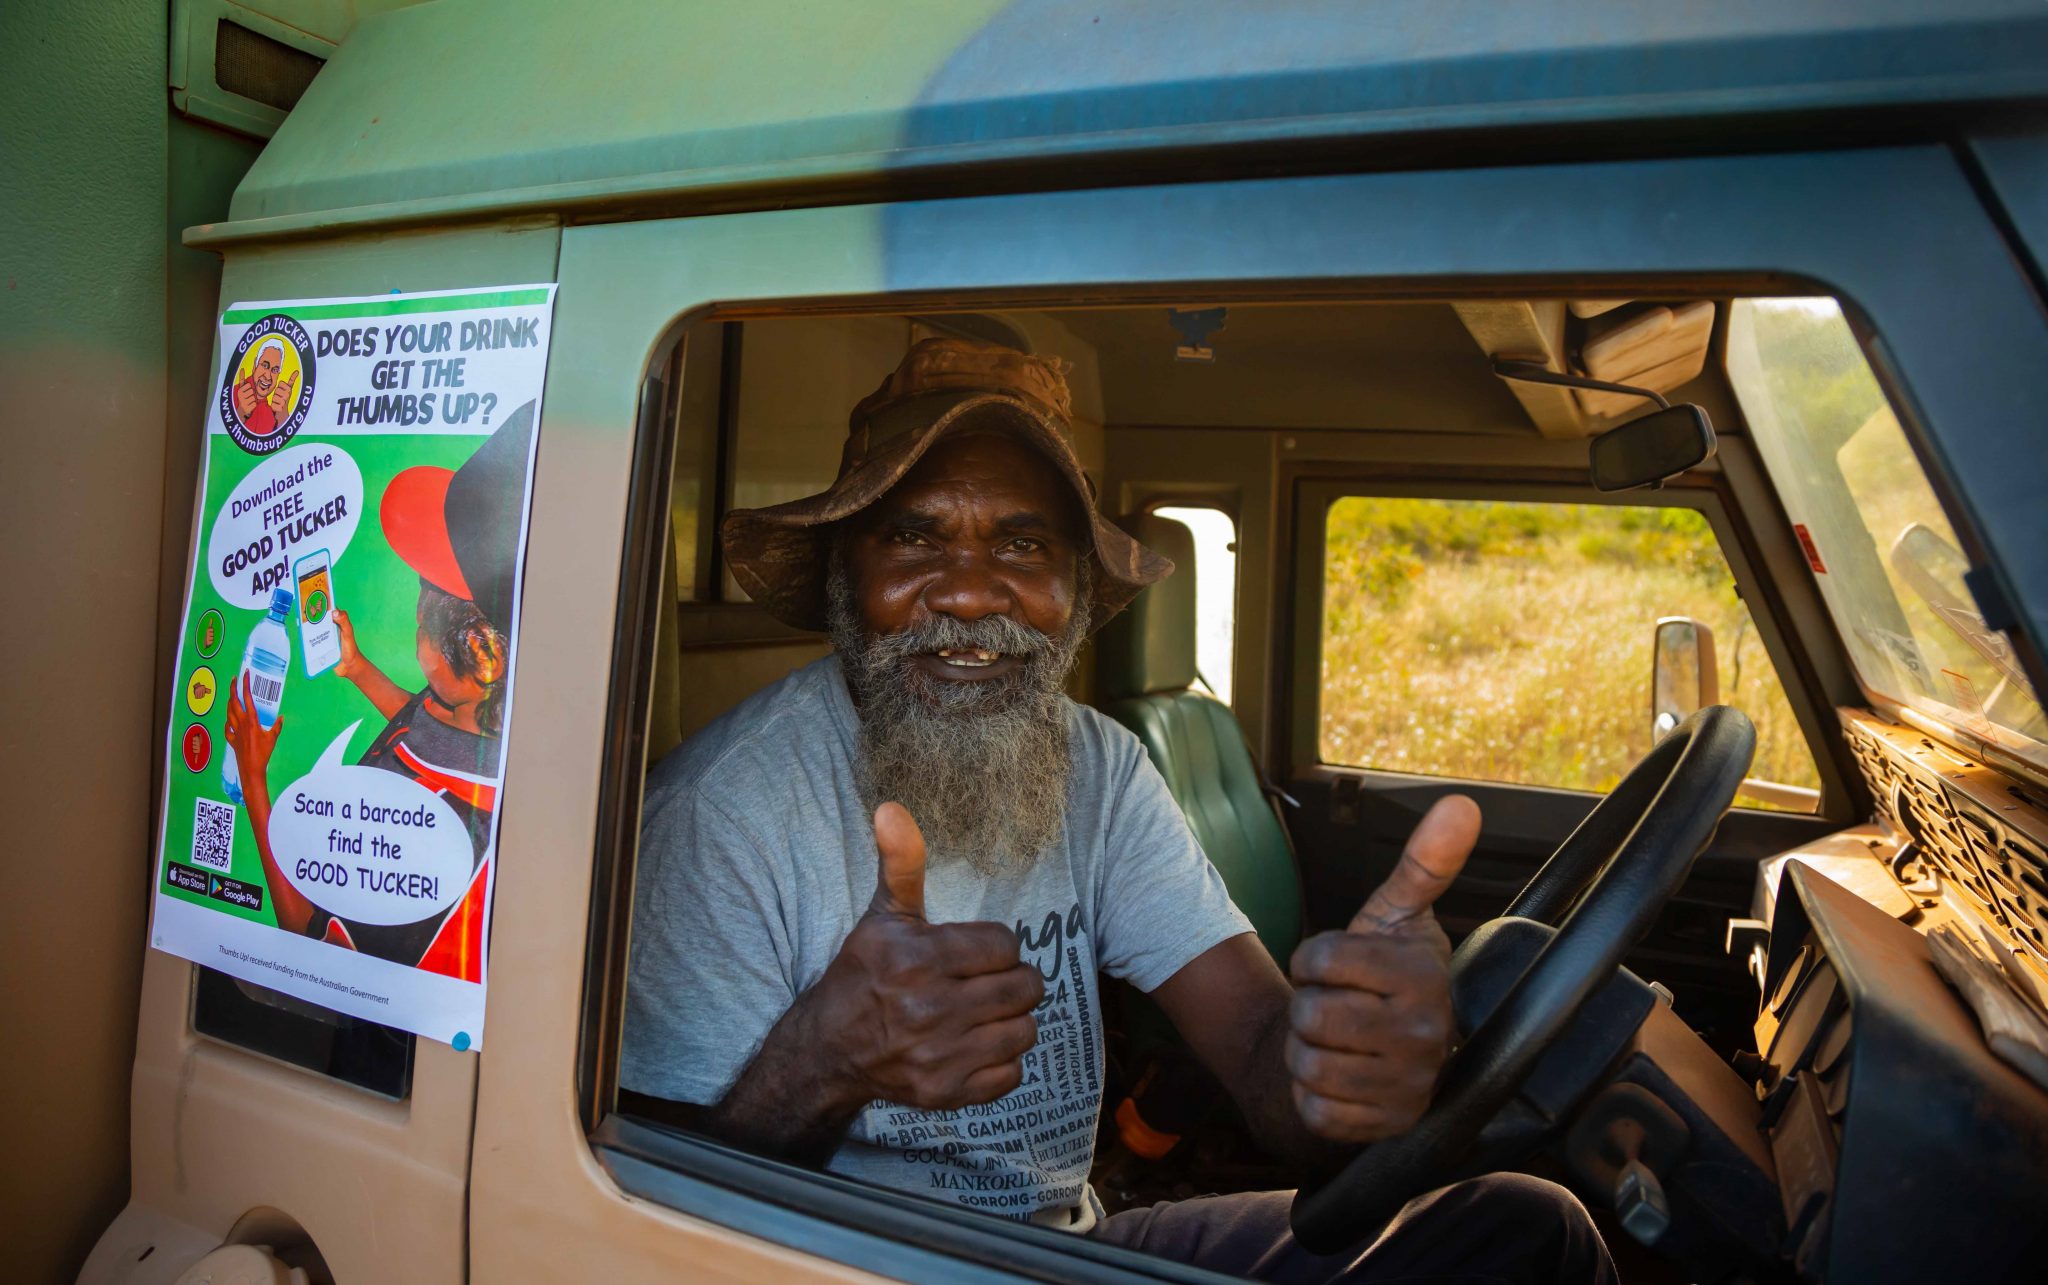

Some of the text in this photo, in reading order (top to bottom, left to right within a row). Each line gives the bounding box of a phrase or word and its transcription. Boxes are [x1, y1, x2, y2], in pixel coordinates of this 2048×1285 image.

[239, 318, 309, 353] GOOD TUCKER
[317, 317, 540, 357] DOES YOUR DRINK
[371, 358, 466, 390] GET THE
[222, 385, 312, 452] www.thumbsup.org.au
[336, 393, 497, 426] THUMBS UP?
[231, 452, 332, 519] Download the
[263, 491, 305, 531] FREE
[222, 495, 348, 578] GOOD TUCKER
[294, 792, 436, 829] Scan a barcode
[328, 829, 402, 860] find the
[177, 874, 206, 890] App Store
[223, 888, 260, 907] Google Play
[295, 858, 439, 901] GOOD TUCKER!
[1015, 902, 1087, 982] nga
[219, 944, 390, 1005] Thumbs Up! received funding from the Australian Government
[1036, 1007, 1073, 1027] KAL
[1053, 1041, 1072, 1101] NANGAK
[1066, 1022, 1084, 1094] NARDILMUK
[967, 1110, 1044, 1138] GAMARDI
[958, 1183, 1083, 1207] GORRONG-GORRONG
